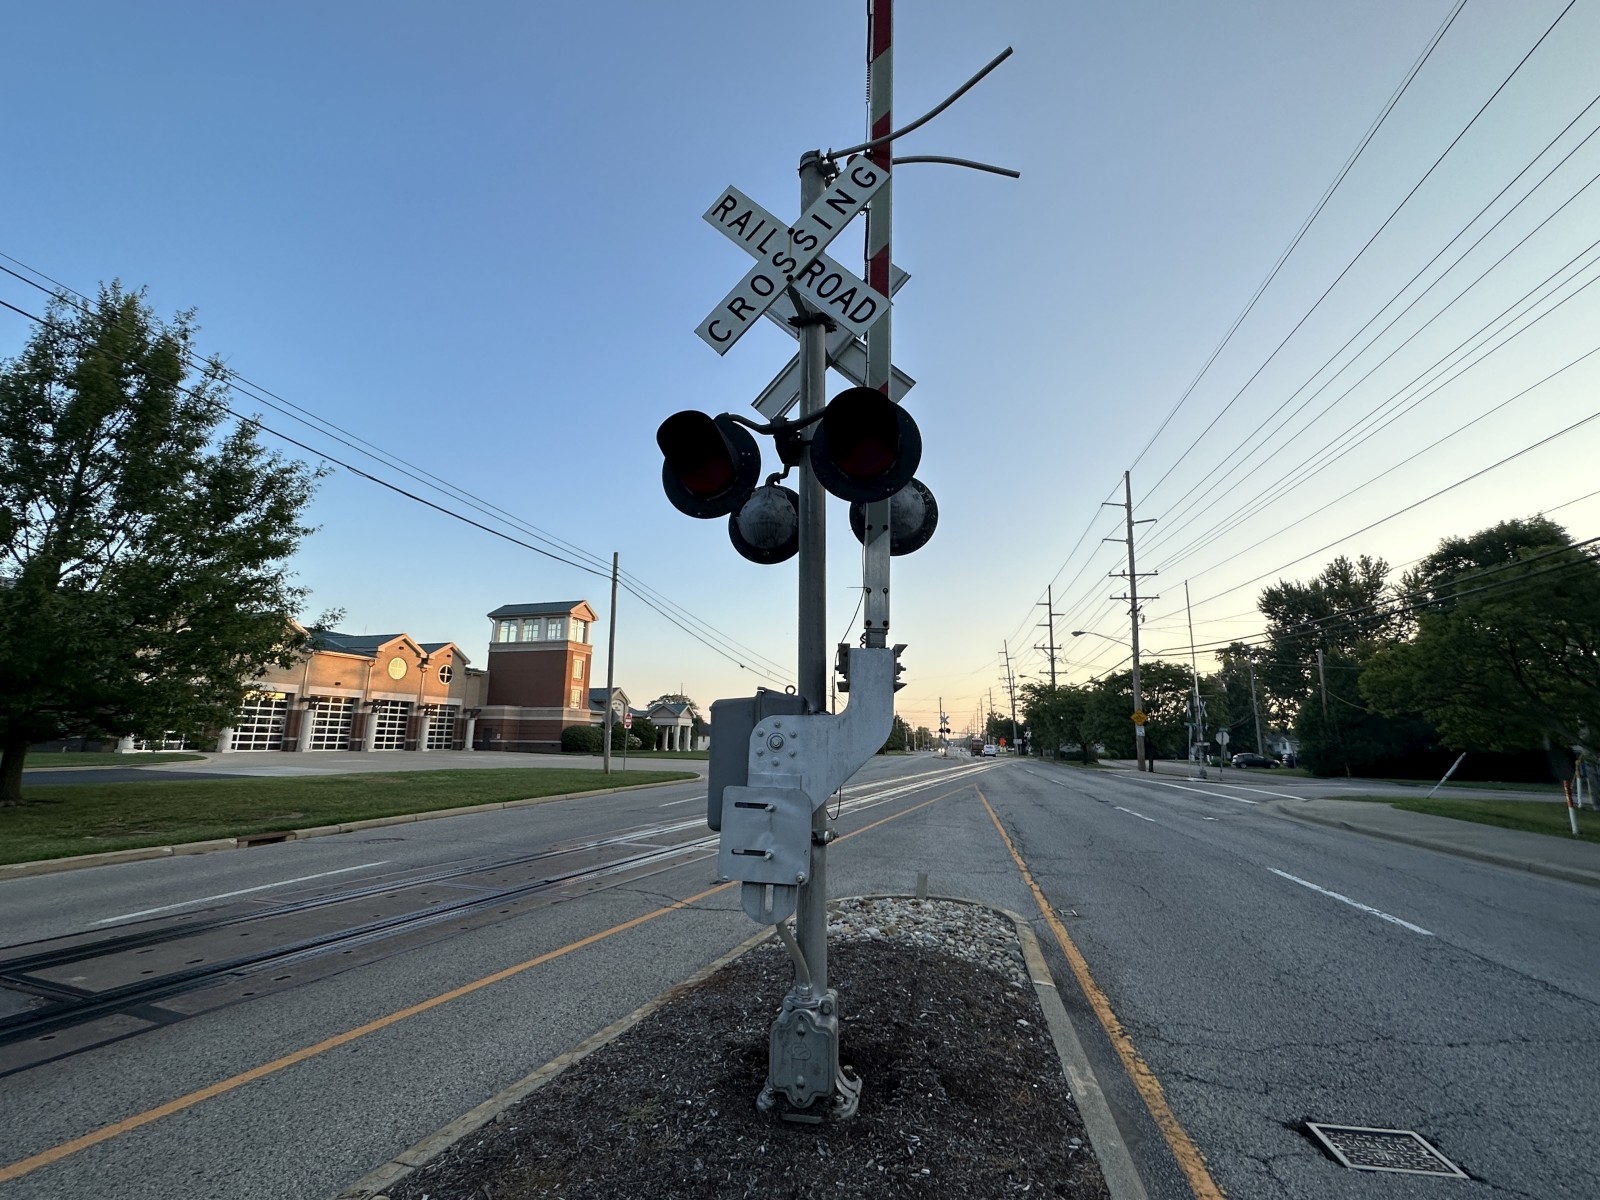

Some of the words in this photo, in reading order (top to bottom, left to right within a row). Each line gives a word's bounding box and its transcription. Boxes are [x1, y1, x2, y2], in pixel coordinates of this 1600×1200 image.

[708, 166, 876, 342] CROSSING
[711, 194, 777, 255] RAIL
[802, 258, 876, 324] ROAD
